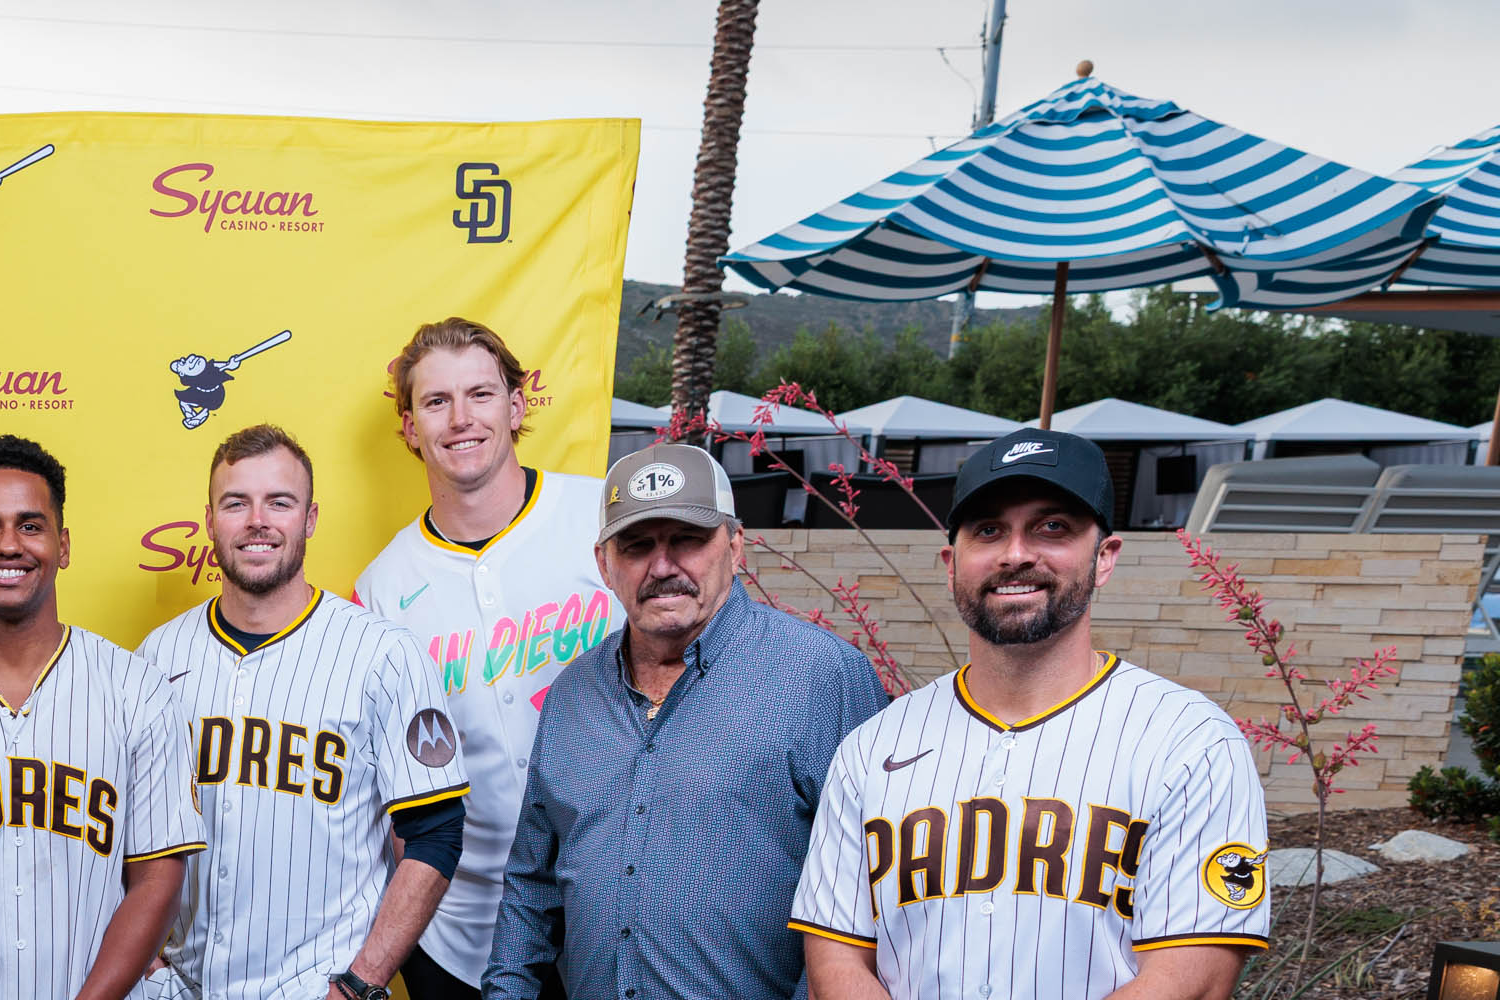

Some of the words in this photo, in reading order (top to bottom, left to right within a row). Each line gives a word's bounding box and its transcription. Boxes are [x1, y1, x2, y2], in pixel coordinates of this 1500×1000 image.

[150, 163, 318, 233] Sycuan
[220, 220, 268, 231] CASINO
[279, 222, 325, 233] RESORT
[30, 400, 74, 409] RESORT
[1009, 441, 1044, 456] NIKE
[483, 589, 612, 686] DIEGO
[189, 715, 347, 806] DRES
